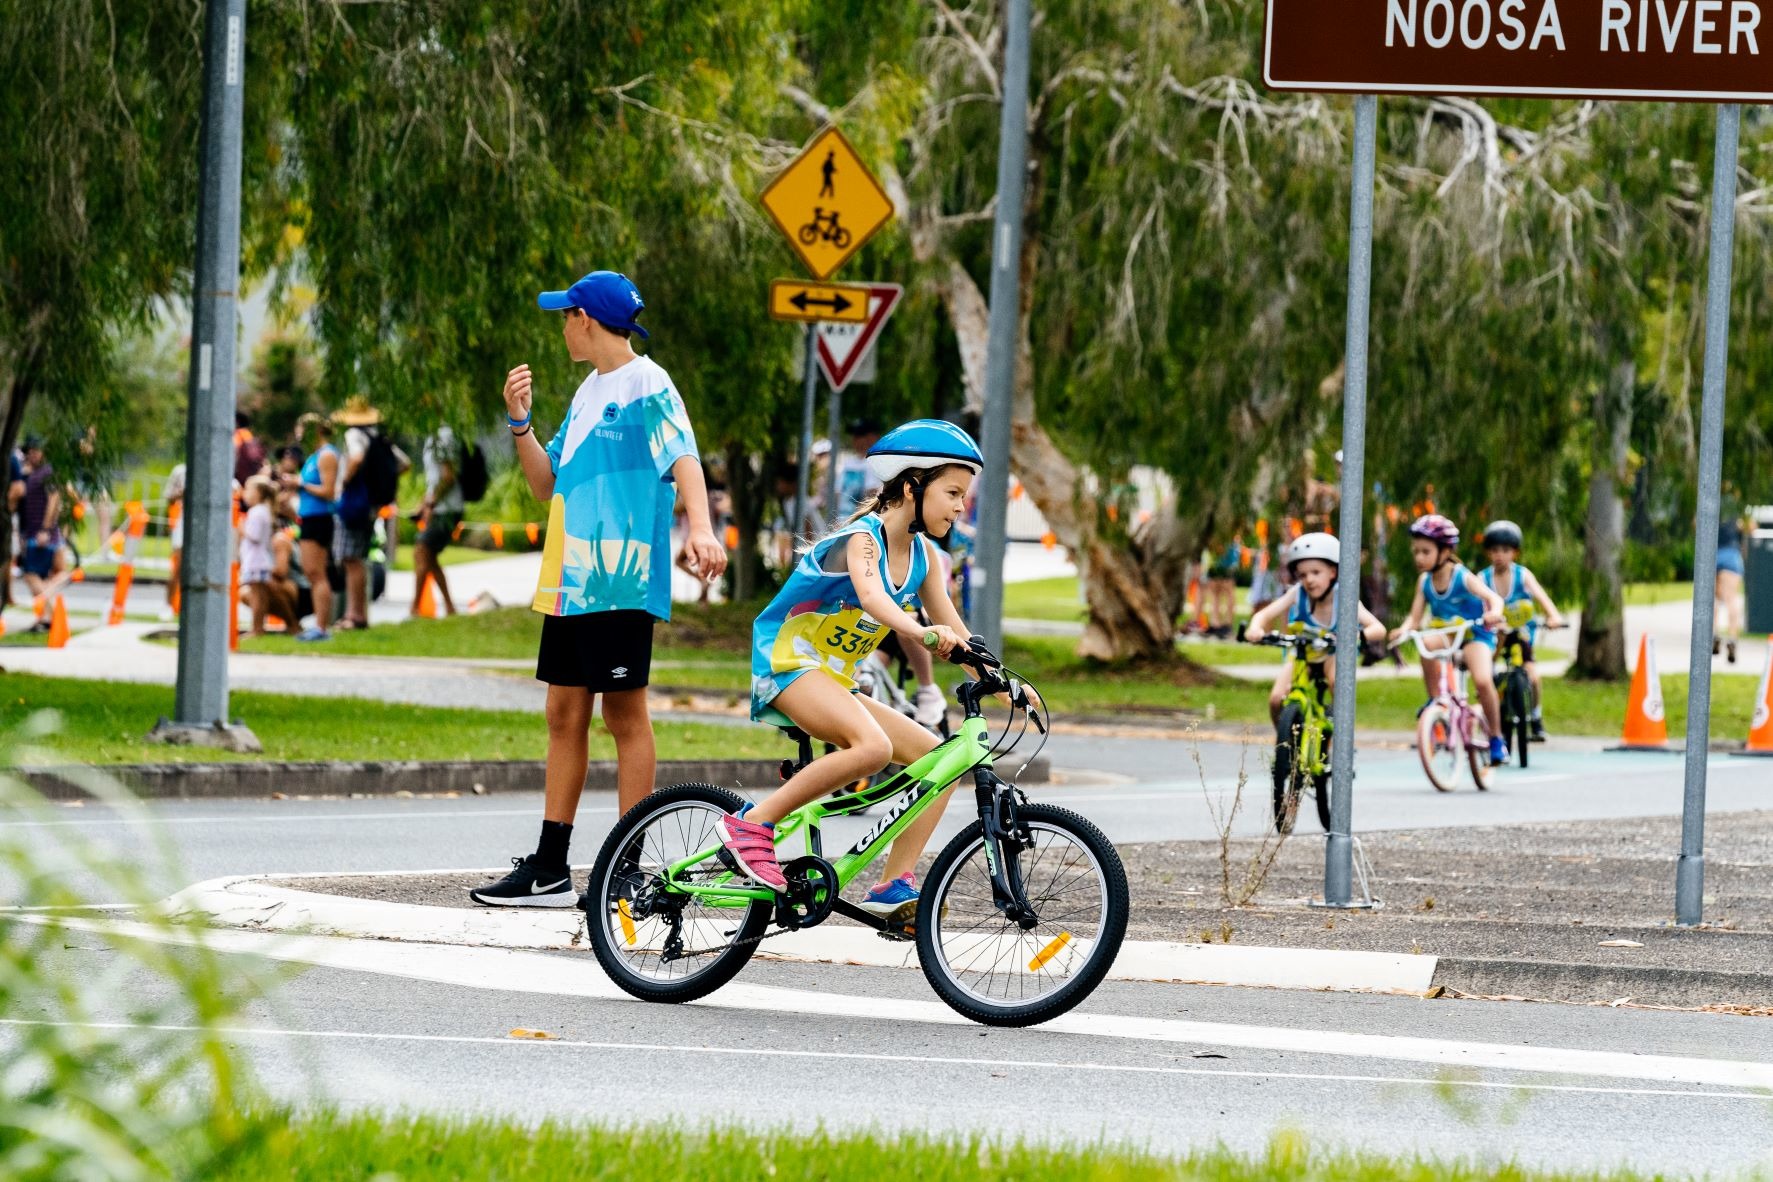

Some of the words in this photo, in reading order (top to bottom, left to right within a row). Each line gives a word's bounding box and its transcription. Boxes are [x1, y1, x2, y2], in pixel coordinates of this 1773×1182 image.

[1385, 0, 1566, 51] NOOSA
[1600, 0, 1761, 55] RIVER
[826, 625, 878, 655] 3316
[856, 781, 921, 852] GIANT
